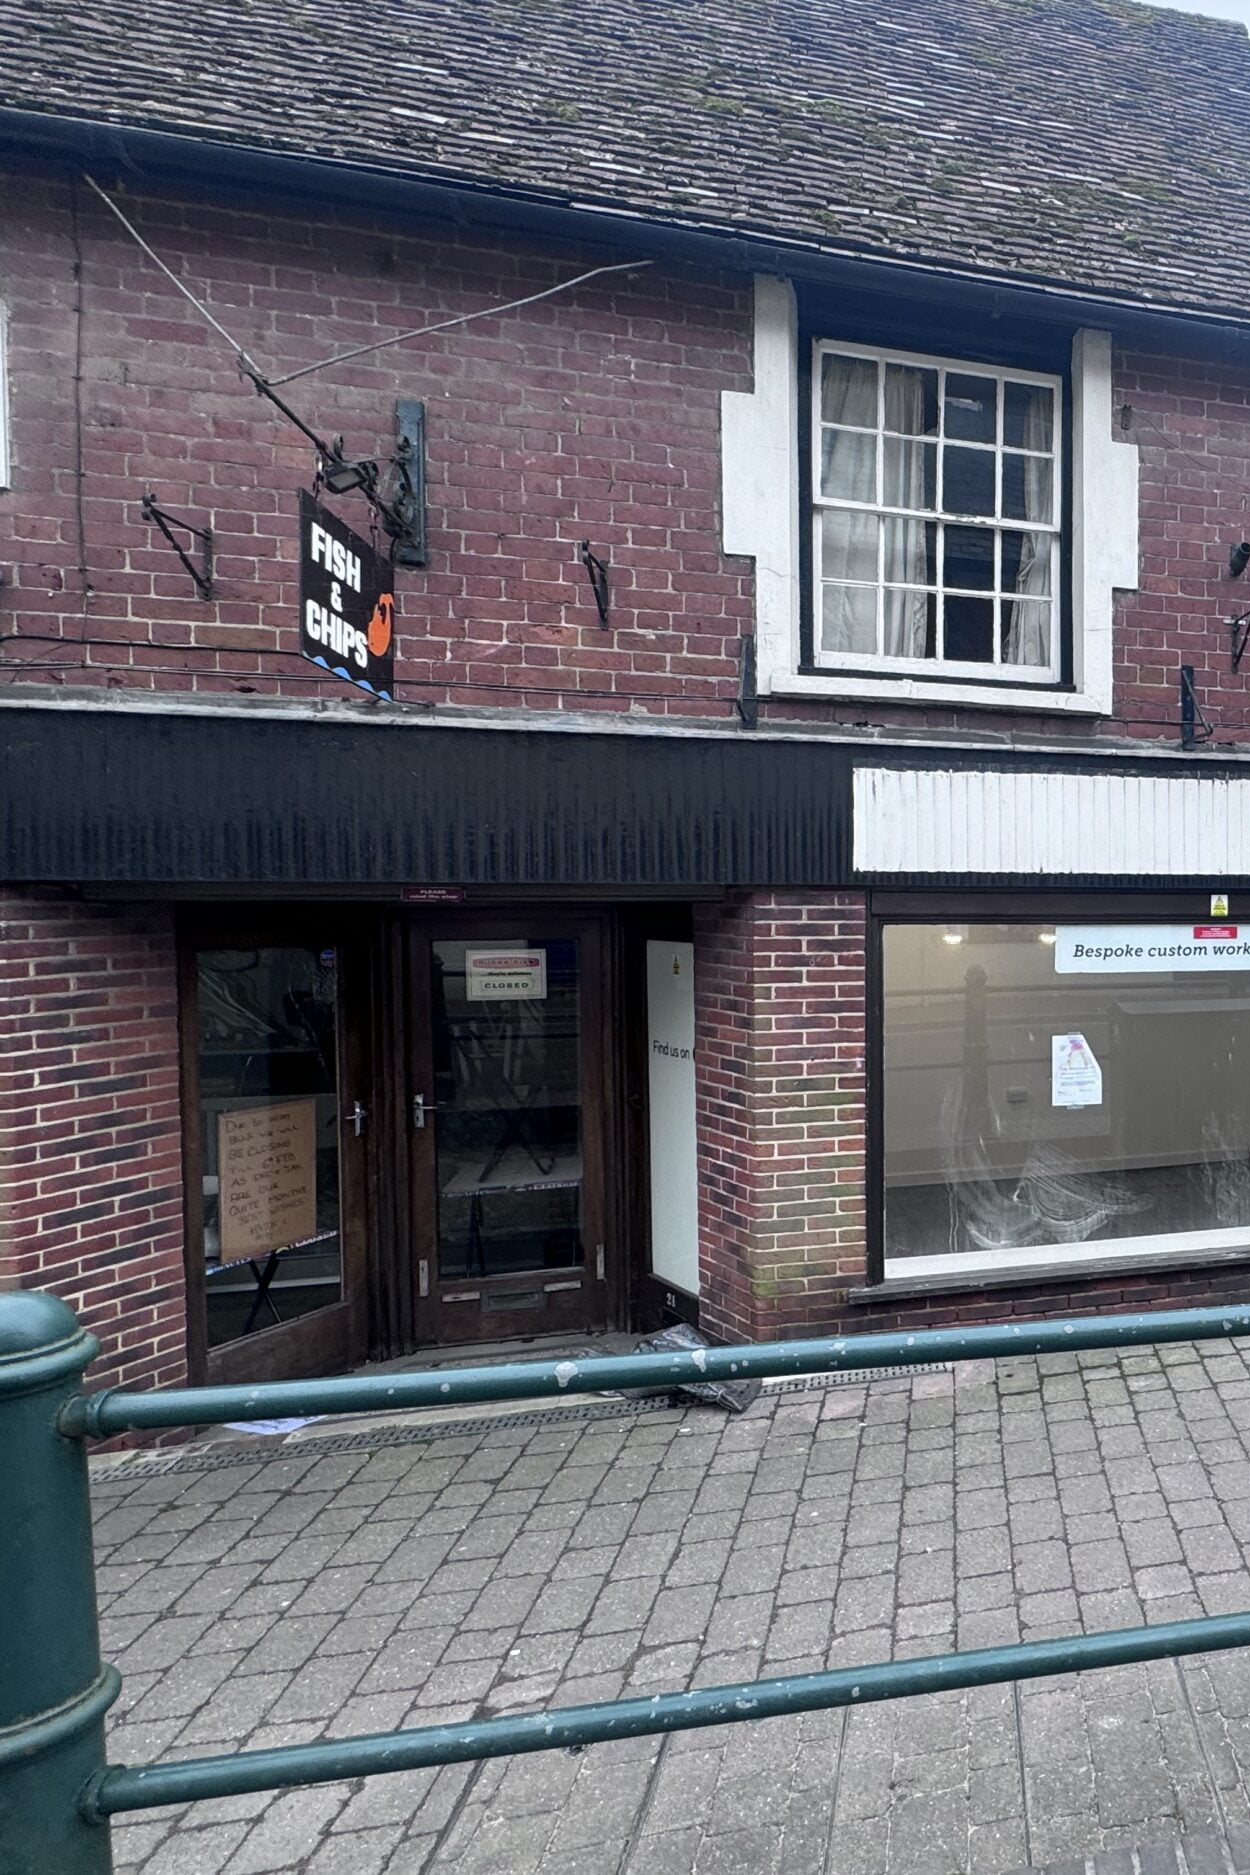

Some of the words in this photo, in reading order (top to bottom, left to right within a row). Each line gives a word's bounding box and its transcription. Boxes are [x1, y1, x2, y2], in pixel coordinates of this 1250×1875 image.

[311, 522, 361, 593] FISH
[330, 581, 343, 612] &
[306, 599, 368, 668] CHIPS
[1072, 943, 1144, 961] Bespoke
[1148, 944, 1208, 957] custom
[653, 1040, 669, 1058] Find
[669, 1046, 680, 1059] us
[680, 1048, 690, 1060] on
